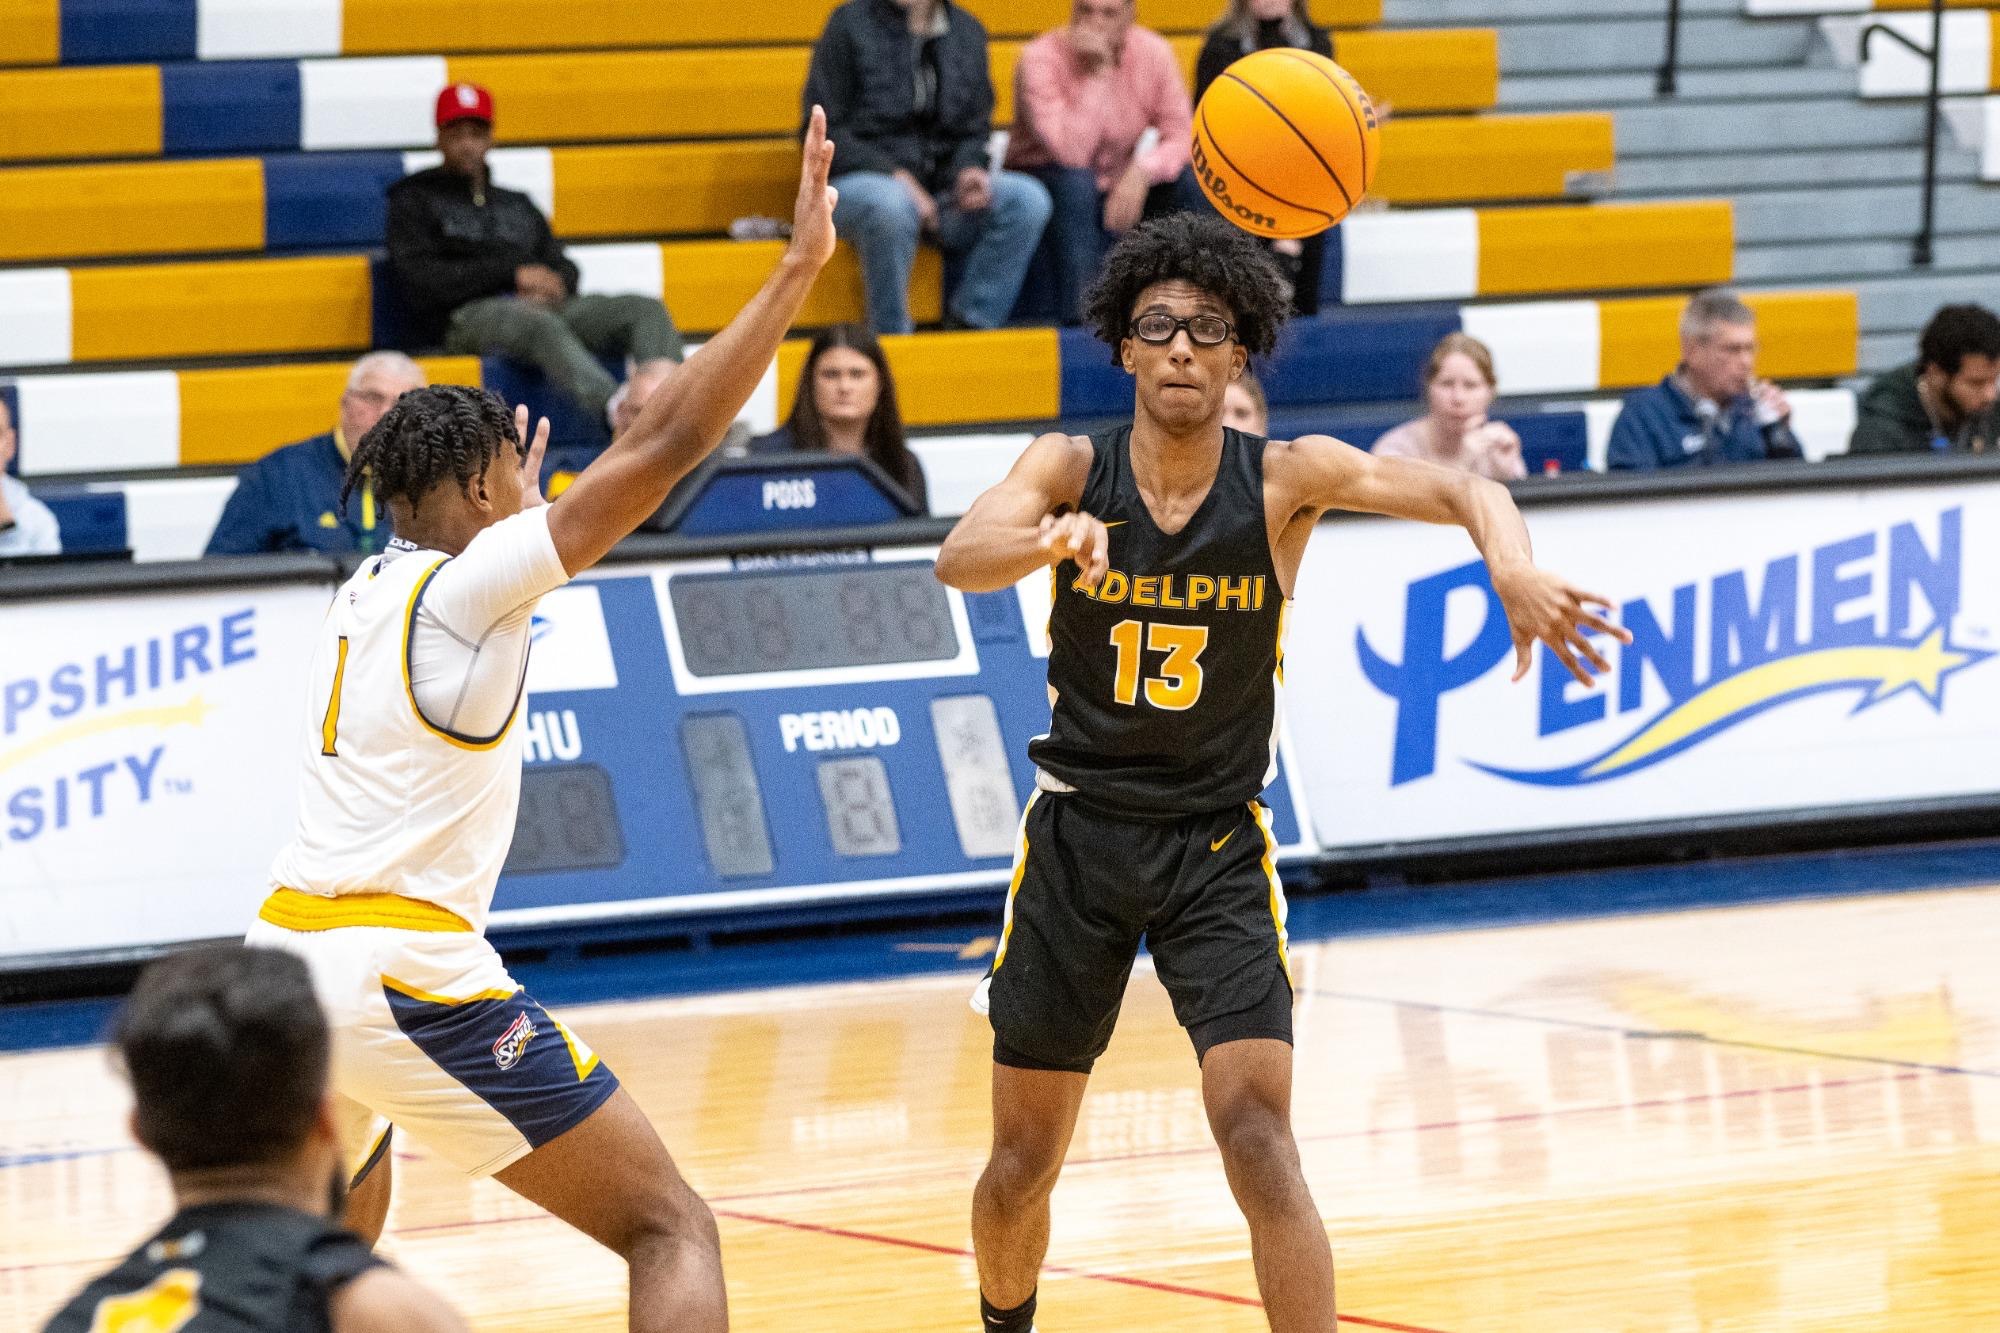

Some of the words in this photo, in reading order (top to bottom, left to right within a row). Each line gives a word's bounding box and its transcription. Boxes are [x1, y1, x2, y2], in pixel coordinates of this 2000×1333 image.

[762, 479, 816, 510] POSS
[322, 635, 349, 757] 1
[1110, 619, 1209, 711] 13
[779, 706, 900, 753] PERIOD
